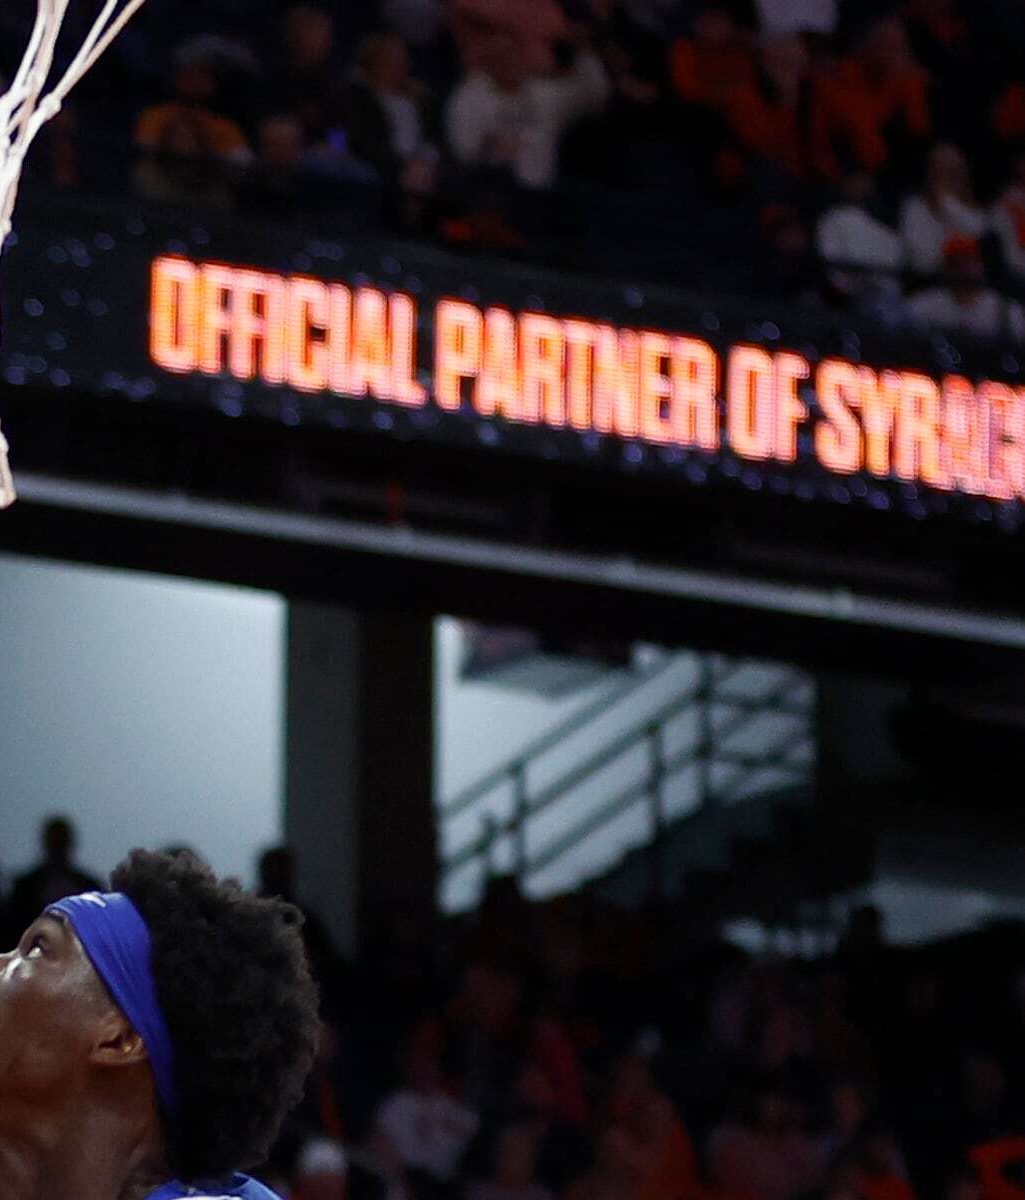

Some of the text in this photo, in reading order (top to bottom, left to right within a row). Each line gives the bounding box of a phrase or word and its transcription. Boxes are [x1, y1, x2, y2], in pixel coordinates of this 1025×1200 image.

[149, 256, 1025, 501] OFFICIAL PARTNER OF SYRAC
